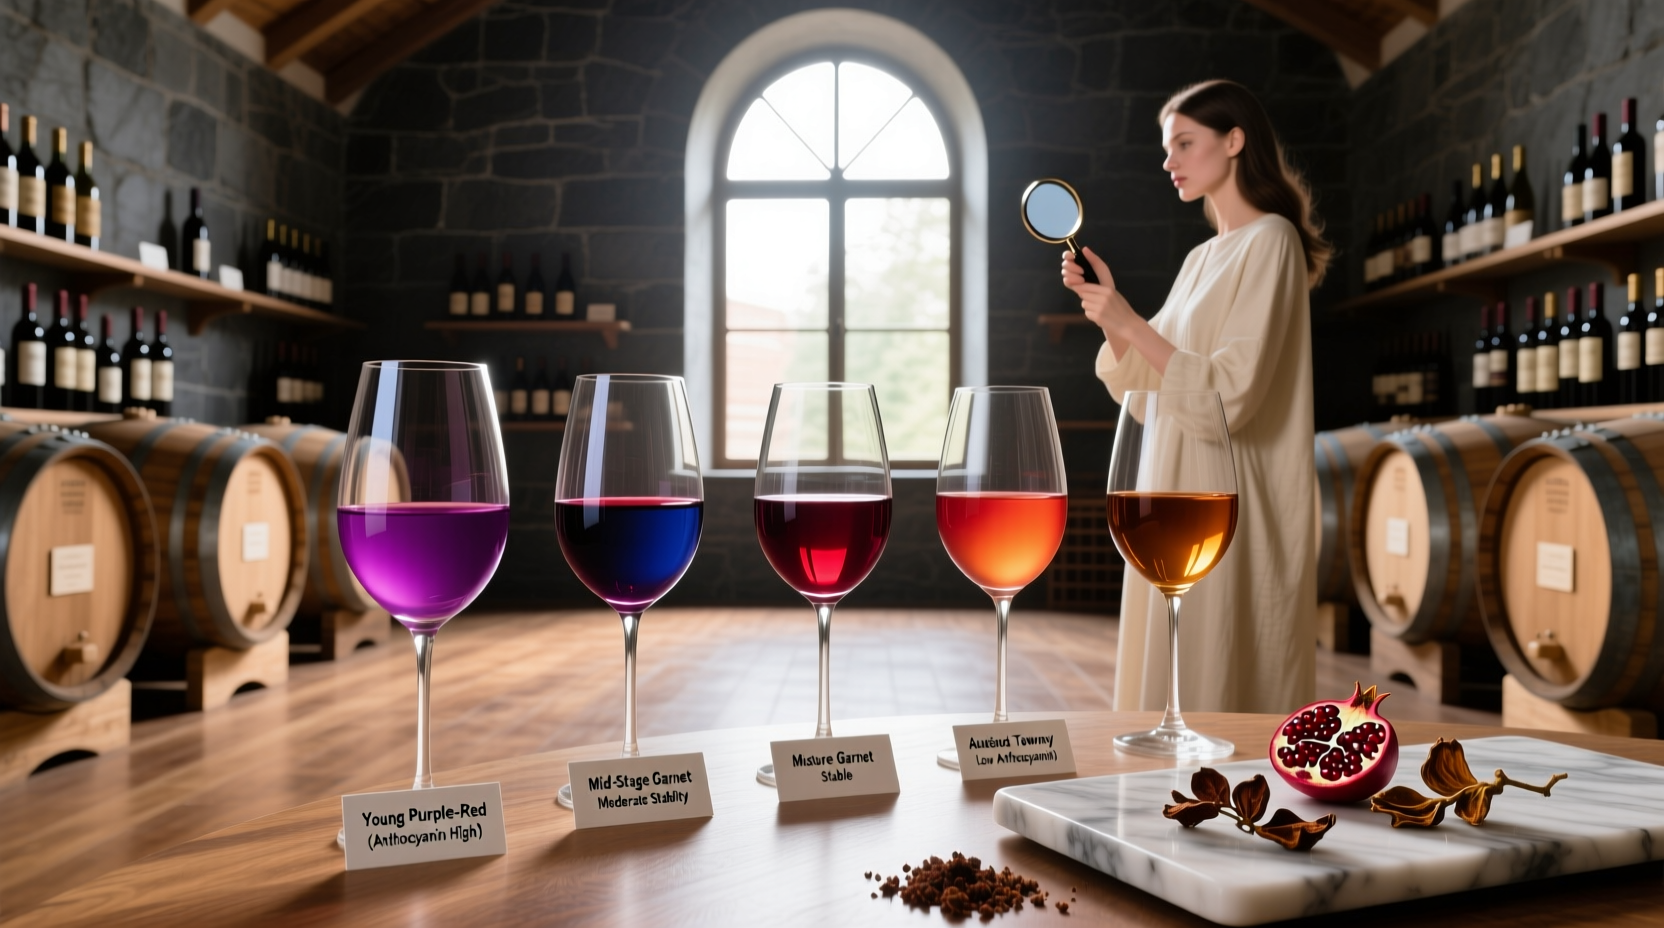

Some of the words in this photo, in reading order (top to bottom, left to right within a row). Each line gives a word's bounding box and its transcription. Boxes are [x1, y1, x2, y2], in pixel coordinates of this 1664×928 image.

[836, 751, 875, 765] Garnet
[588, 774, 650, 791] Mid-Stage
[652, 771, 693, 786] Garnet
[821, 768, 853, 782] Stable
[362, 811, 406, 828] Young
[409, 802, 487, 823] Purple-Red
